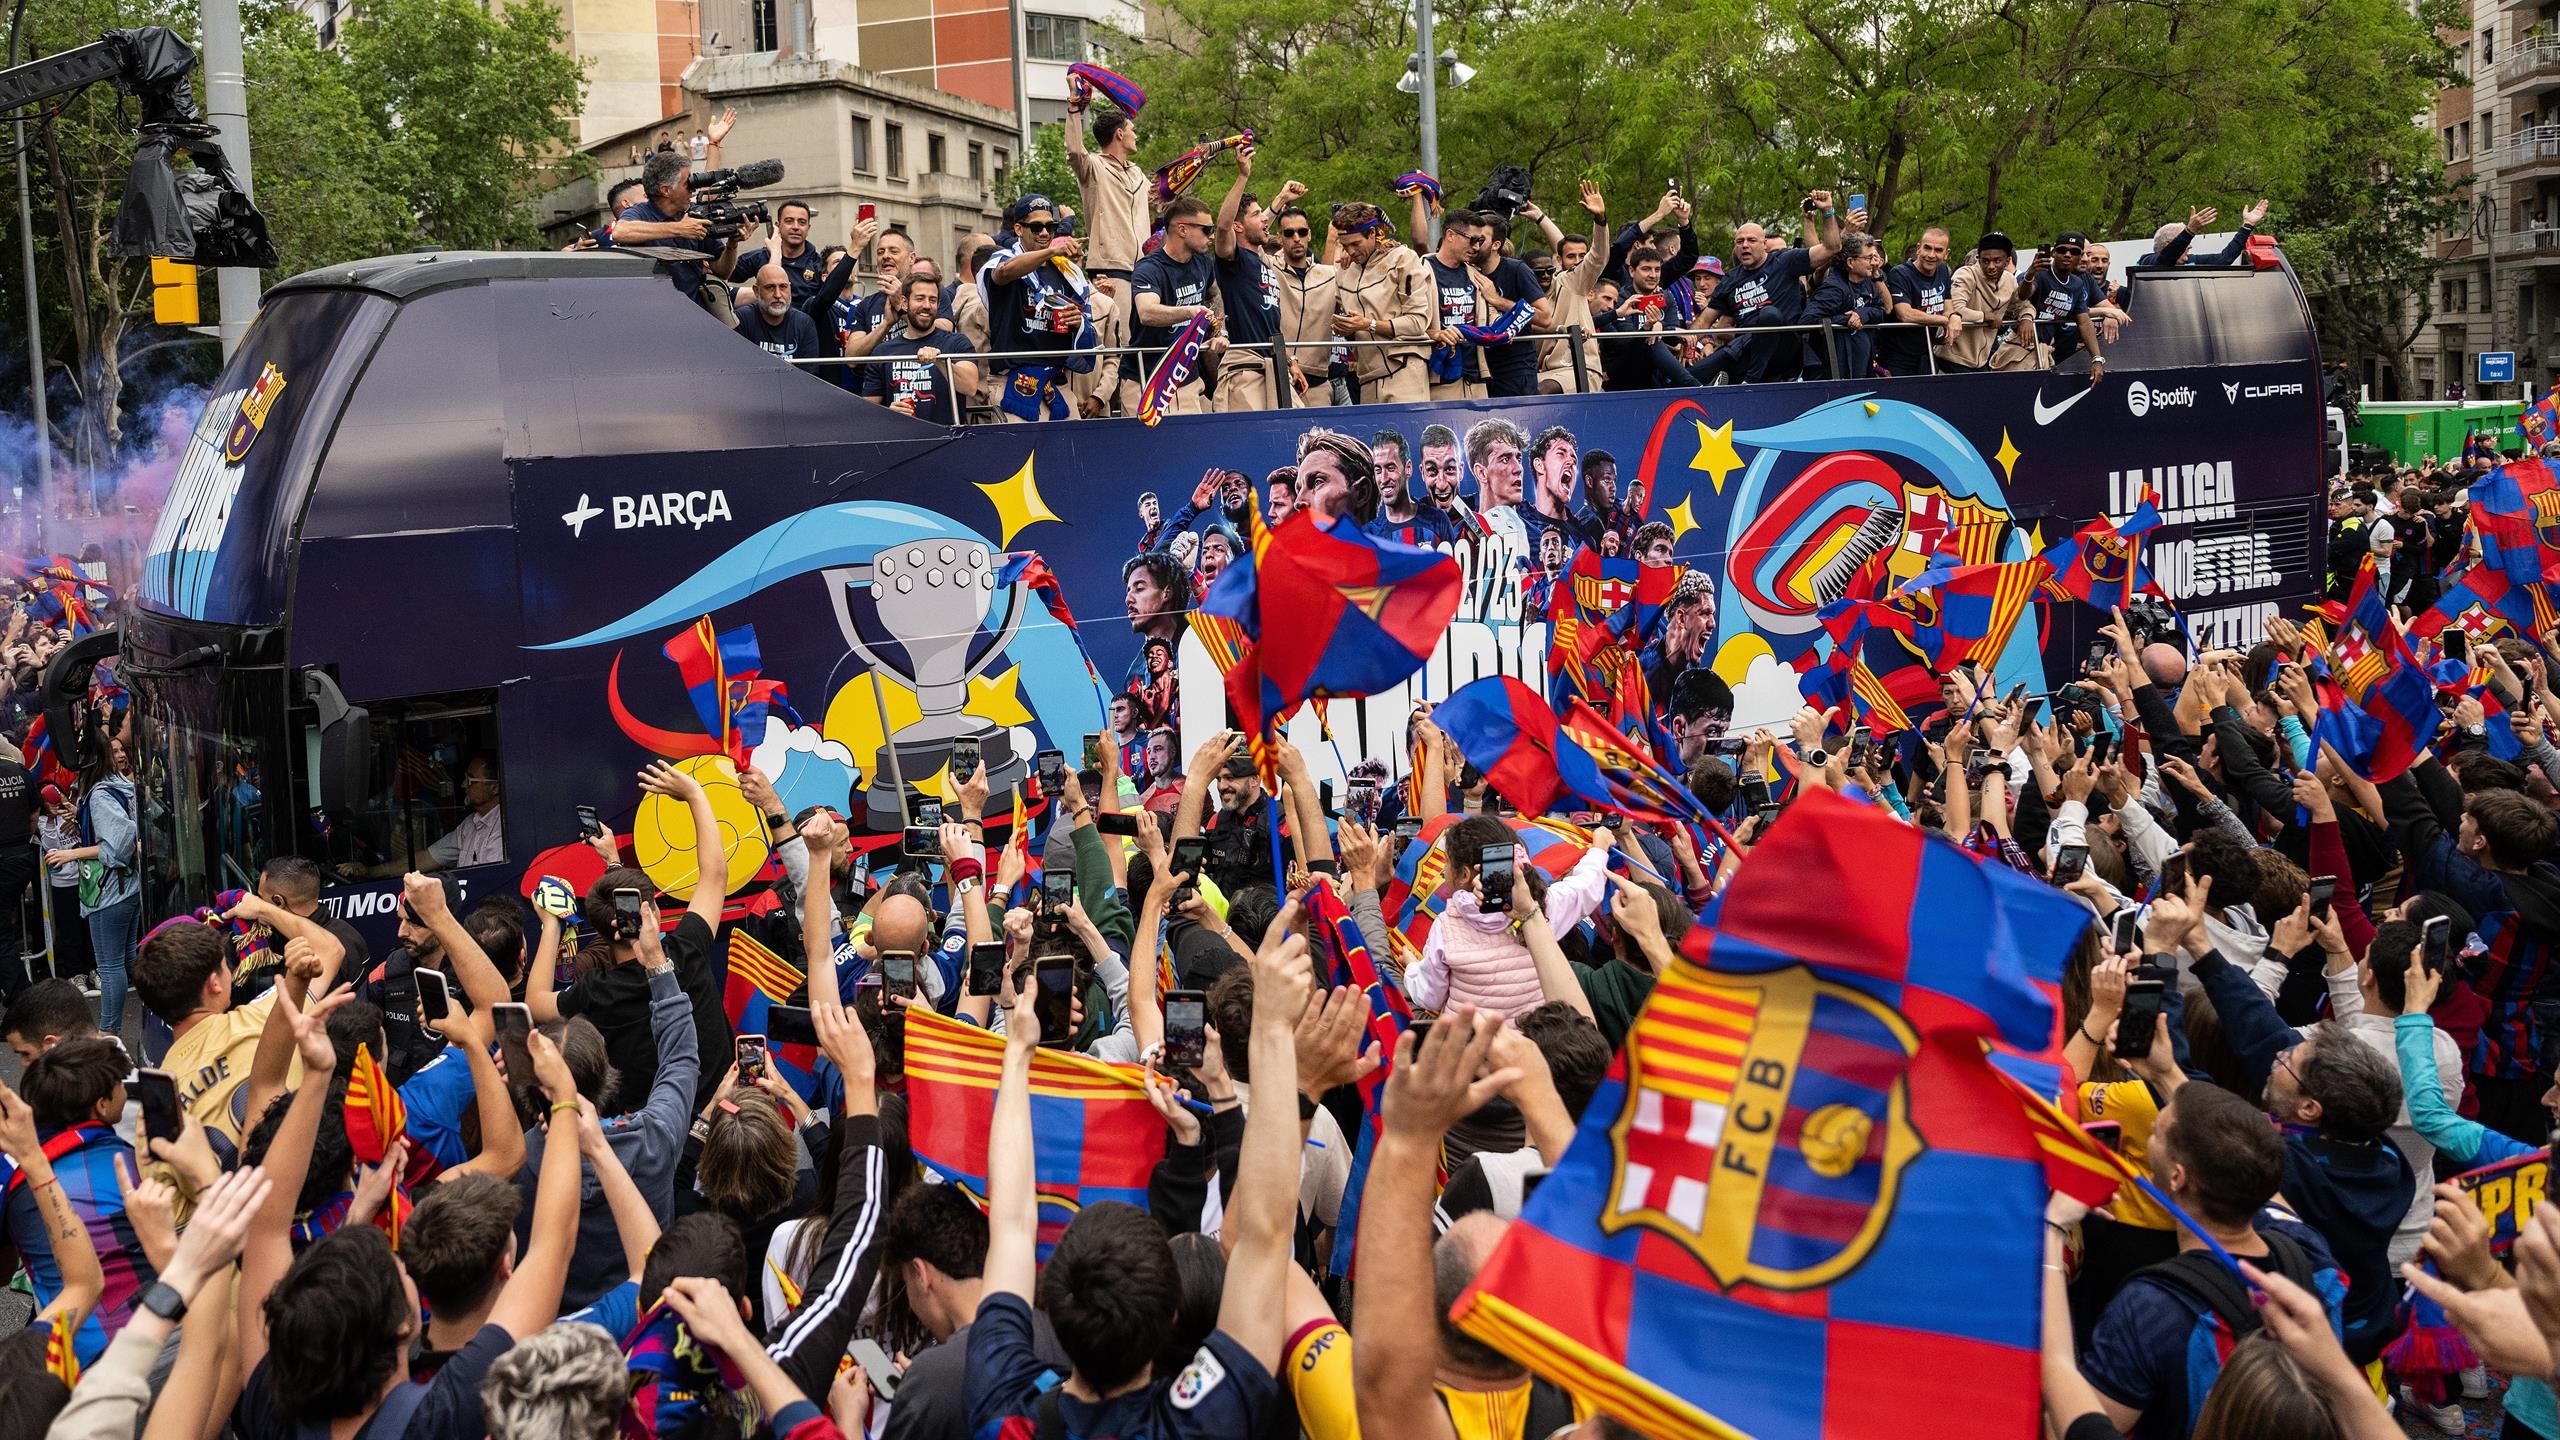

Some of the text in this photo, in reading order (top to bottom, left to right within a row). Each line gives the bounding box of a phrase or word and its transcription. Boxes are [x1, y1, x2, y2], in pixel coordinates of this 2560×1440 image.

[2152, 387, 2195, 408] Spotify
[2245, 384, 2302, 398] CUPRA
[2109, 461, 2236, 528] LA LLIGA
[613, 490, 732, 530] BARÇA
[0, 776, 24, 787] OLICIA
[834, 943, 858, 966] eko
[386, 1010, 410, 1022] POLICIA
[180, 1055, 231, 1111] ALDE
[1722, 1057, 1787, 1178] FCB
